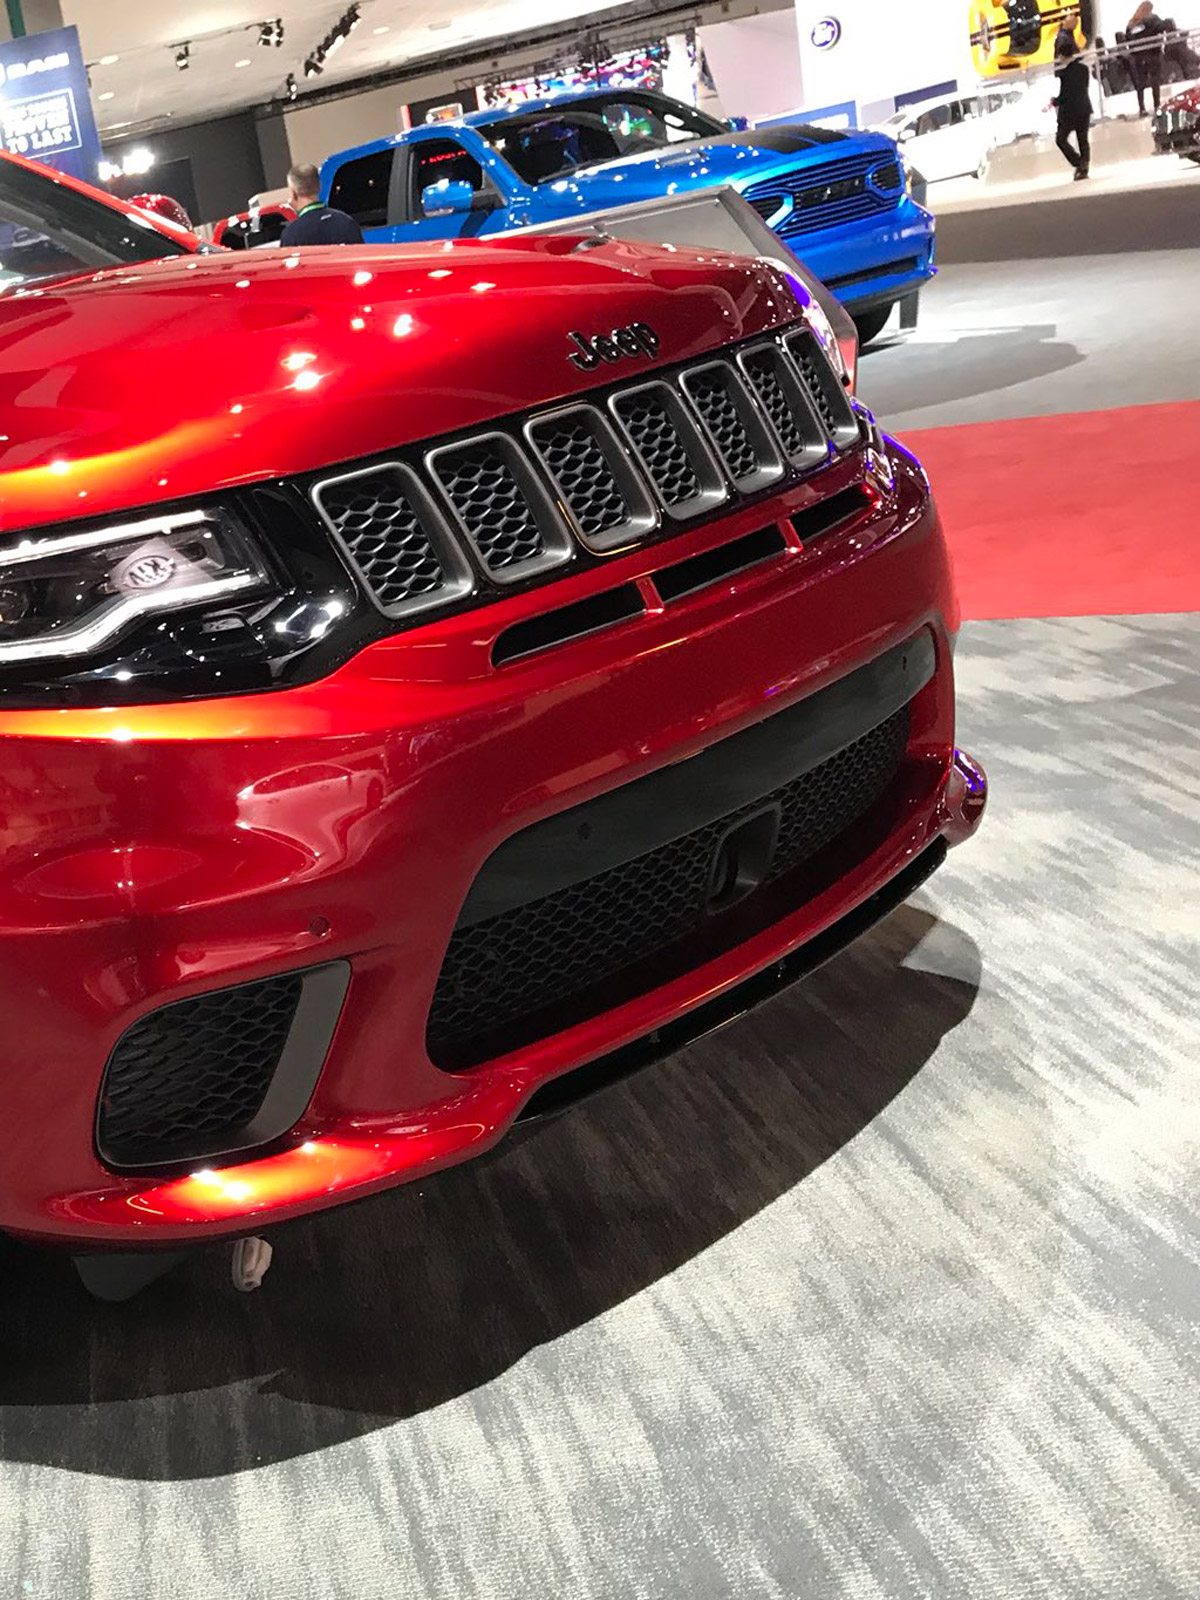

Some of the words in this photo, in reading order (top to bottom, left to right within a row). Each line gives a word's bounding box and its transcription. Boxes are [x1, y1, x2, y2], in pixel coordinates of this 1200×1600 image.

[6, 136, 28, 154] TO
[30, 125, 72, 149] LAST
[566, 322, 661, 371] Jeep
